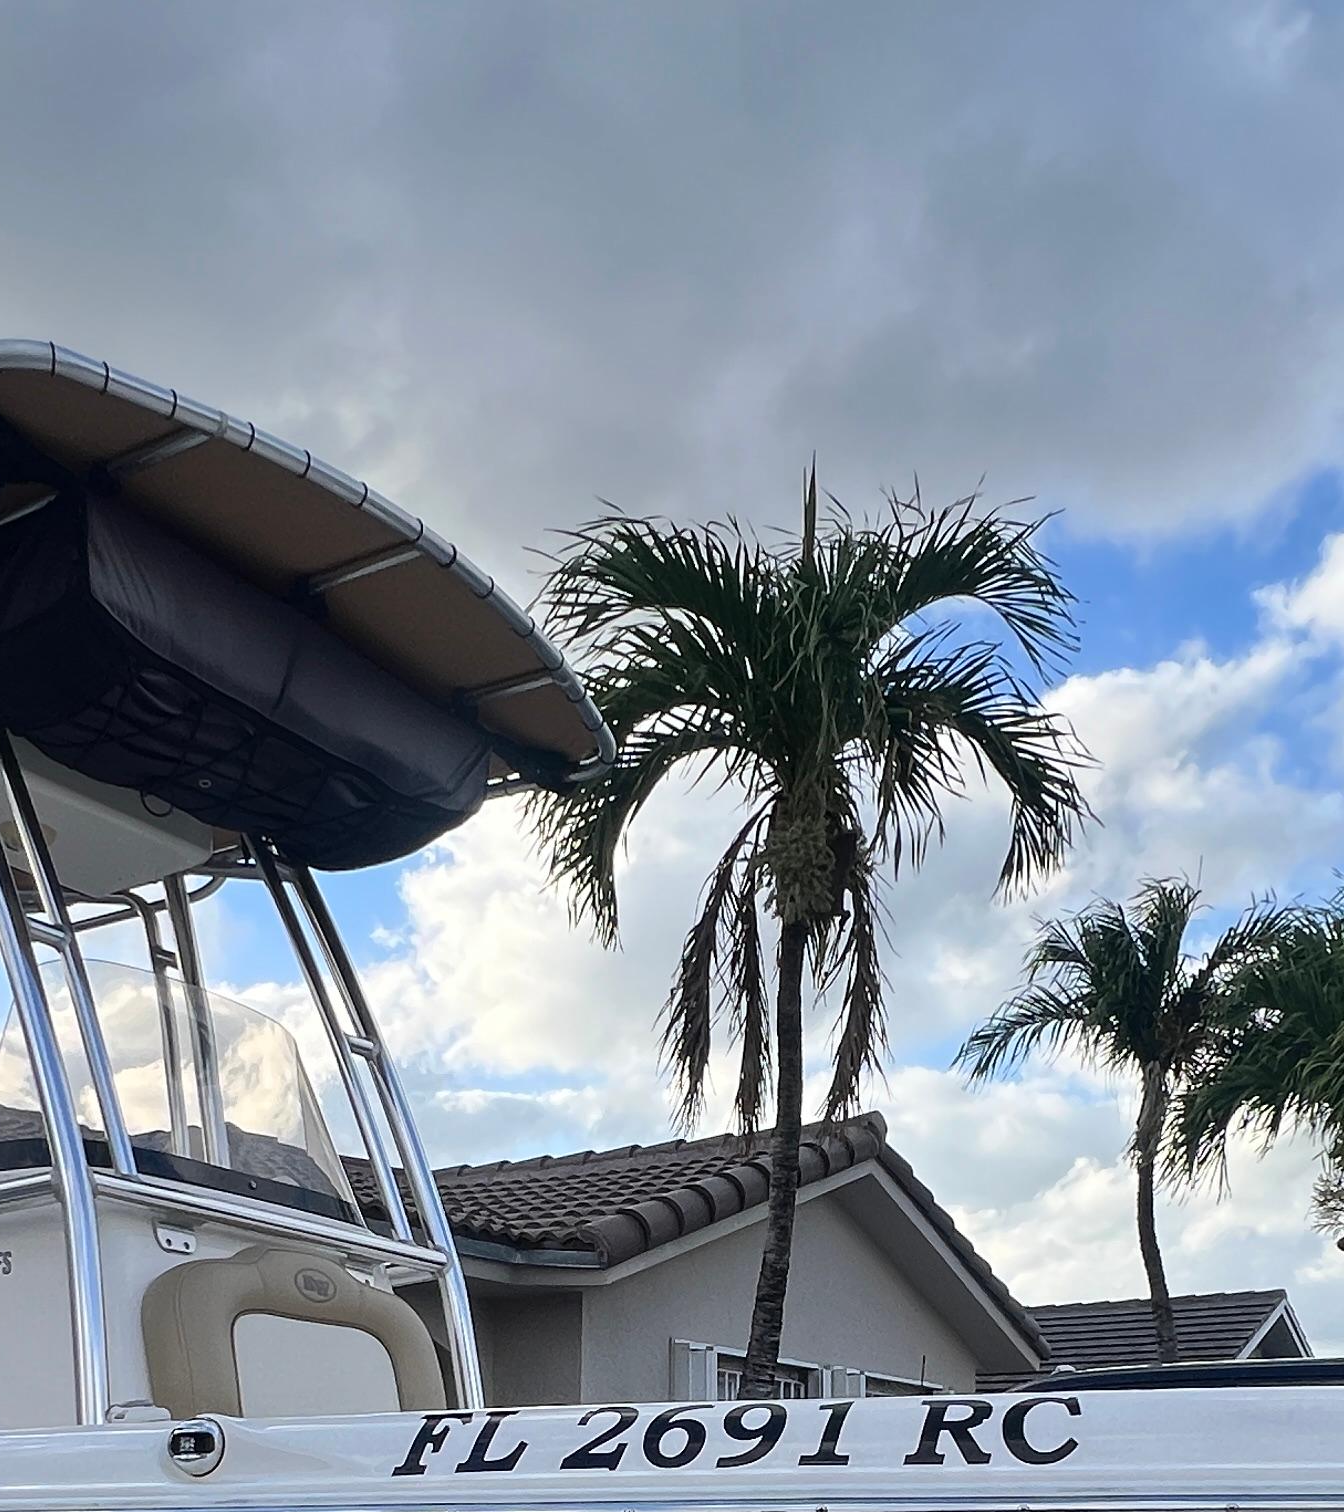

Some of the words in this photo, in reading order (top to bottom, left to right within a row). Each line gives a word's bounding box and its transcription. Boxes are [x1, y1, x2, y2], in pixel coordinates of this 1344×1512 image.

[392, 1410, 530, 1477] FL
[559, 1400, 856, 1472] 2691
[902, 1396, 1083, 1467] RC
